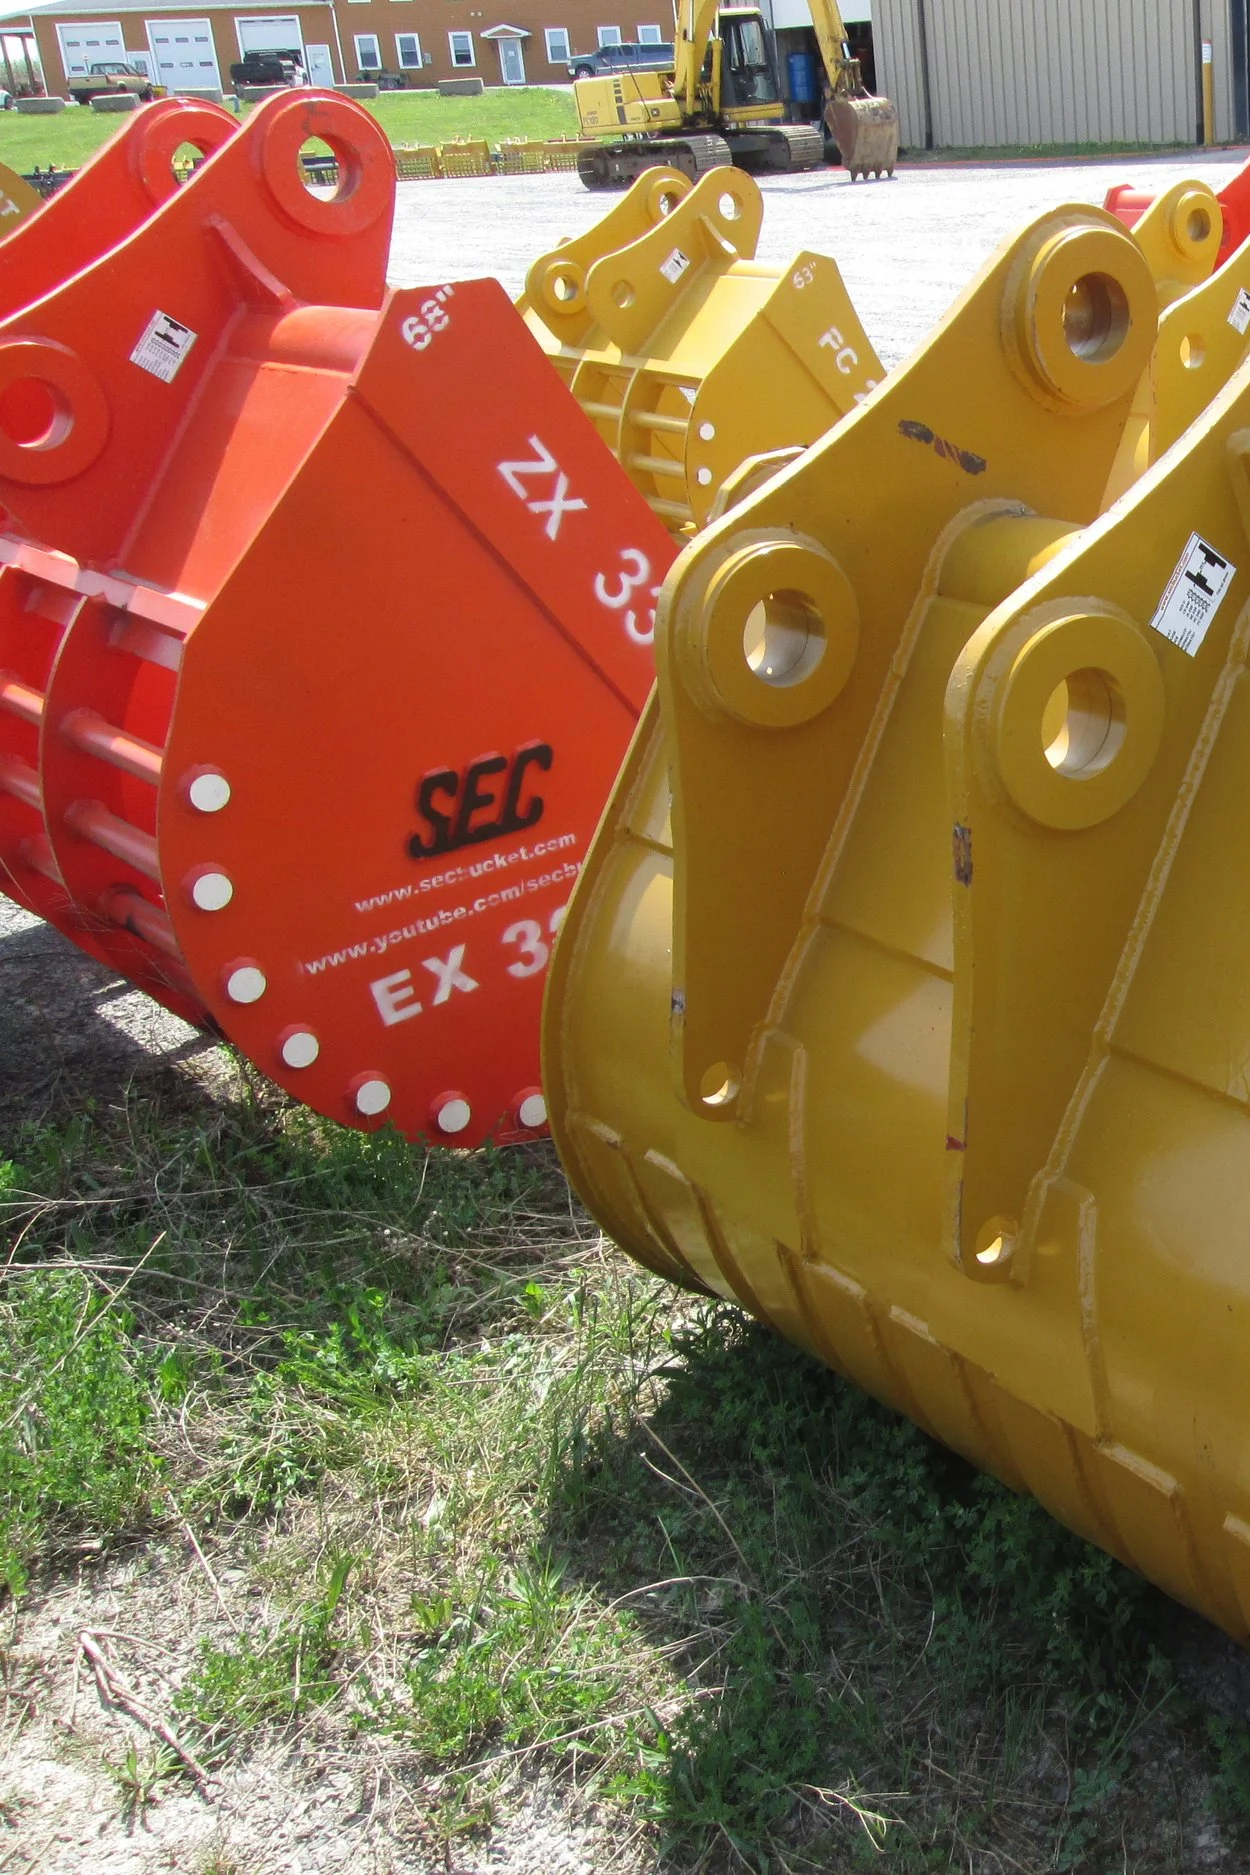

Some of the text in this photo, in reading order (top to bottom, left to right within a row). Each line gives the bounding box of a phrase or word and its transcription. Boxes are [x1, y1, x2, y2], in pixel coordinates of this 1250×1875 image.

[402, 284, 455, 351] 68"
[818, 325, 858, 374] PC
[496, 433, 589, 541] ZX
[405, 740, 553, 860] SEC
[354, 831, 576, 913] www.secbucket.com
[370, 943, 480, 1028] EX
